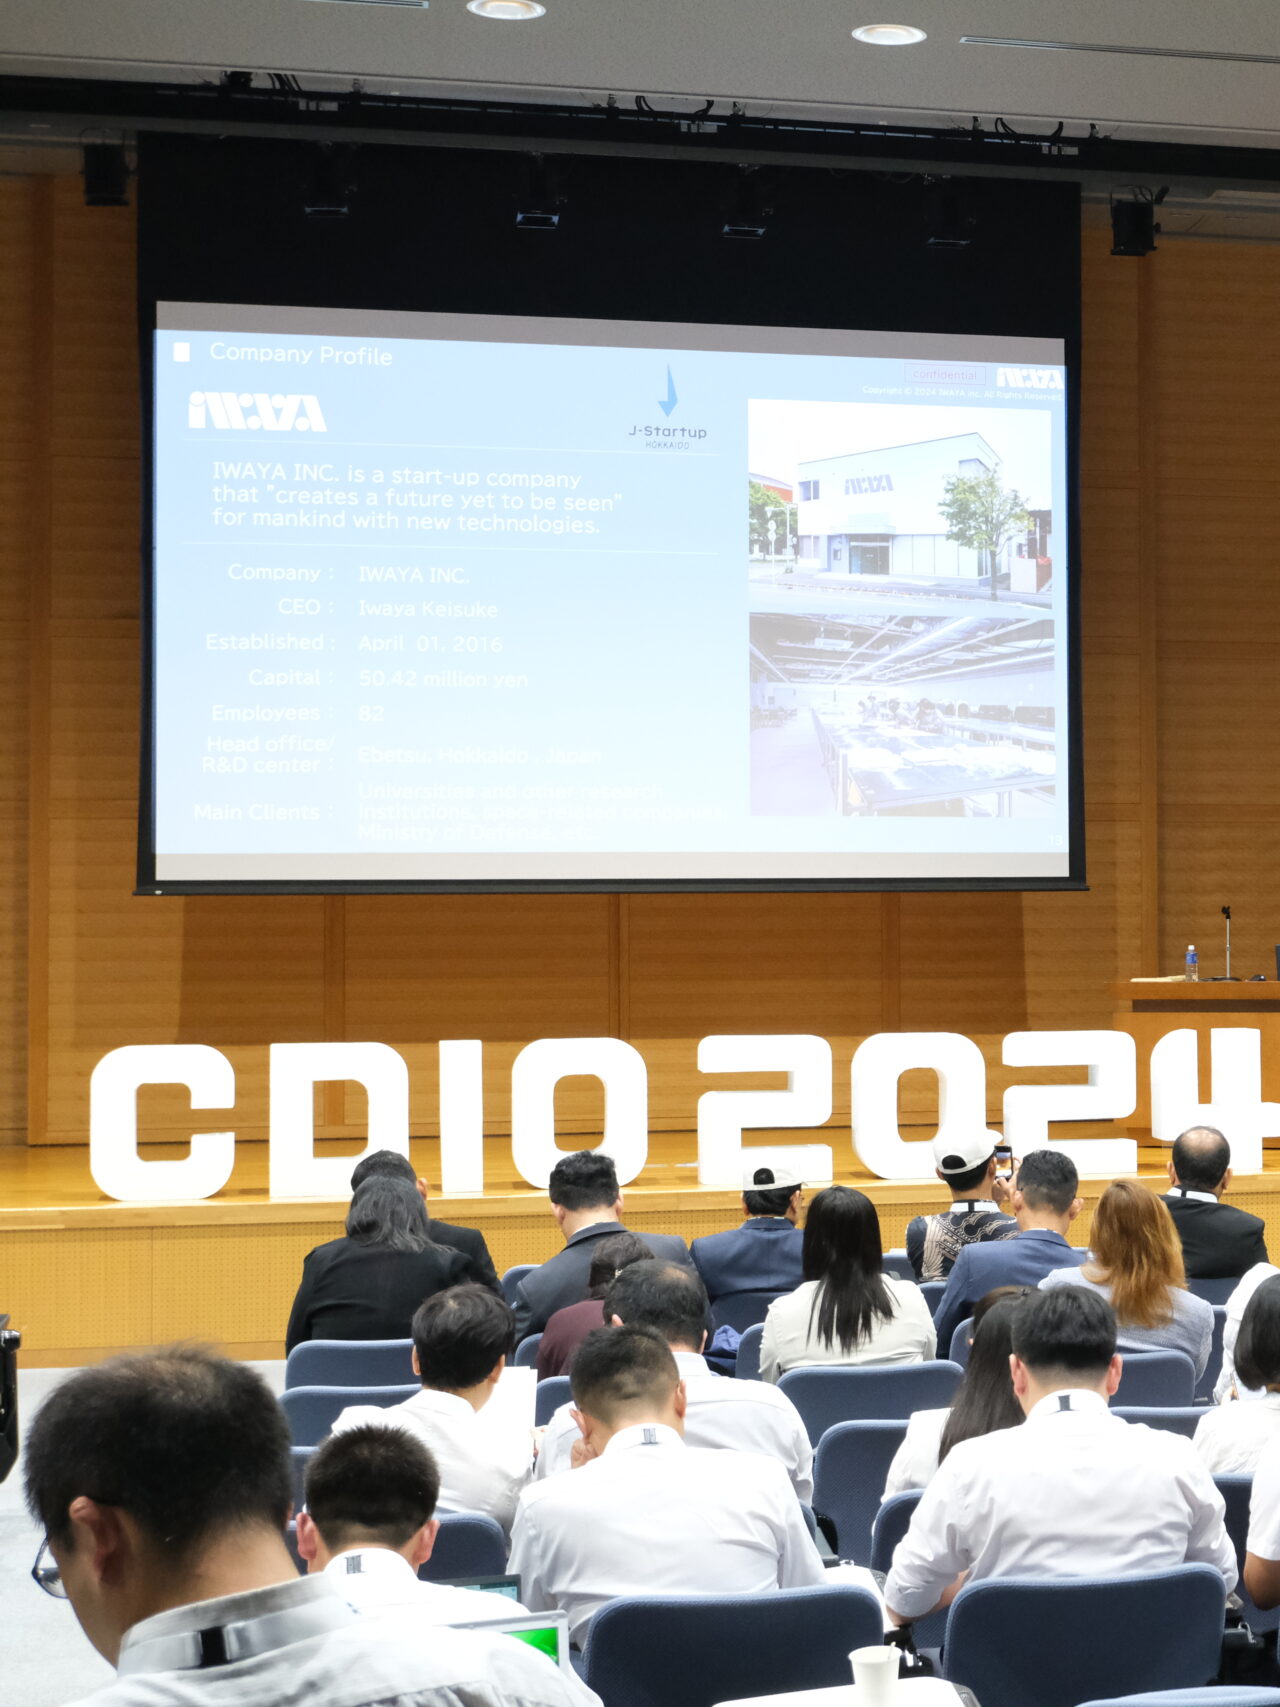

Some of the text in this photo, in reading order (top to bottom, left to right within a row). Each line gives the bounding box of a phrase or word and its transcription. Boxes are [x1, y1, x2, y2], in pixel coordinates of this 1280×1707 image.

[210, 342, 393, 366] Company Profile
[912, 367, 977, 381] confidential
[213, 462, 581, 489] IWAYA INC. is a start-up company
[213, 485, 622, 512] that "creates a future yet to be seen"
[213, 508, 600, 535] for mankind with new technologies.
[228, 564, 321, 583] Company
[359, 566, 423, 583] IWAYA
[430, 568, 470, 584] INC.
[277, 599, 321, 615] CEO
[359, 600, 415, 617] Iwaya
[422, 600, 498, 617] Keisuke
[206, 633, 323, 651] Established
[359, 635, 403, 652] April
[453, 636, 502, 652] 2016
[248, 669, 320, 687] Capital
[359, 669, 416, 687] 50.42
[423, 671, 485, 687] million
[493, 674, 528, 690] yen
[211, 704, 321, 722] Employees
[359, 705, 385, 721] 82
[208, 734, 335, 752] Head office/
[202, 756, 248, 774] R&D
[254, 758, 321, 774] center
[194, 804, 242, 821] Main
[249, 803, 321, 821] Clients
[89, 1037, 648, 1202] CDIO
